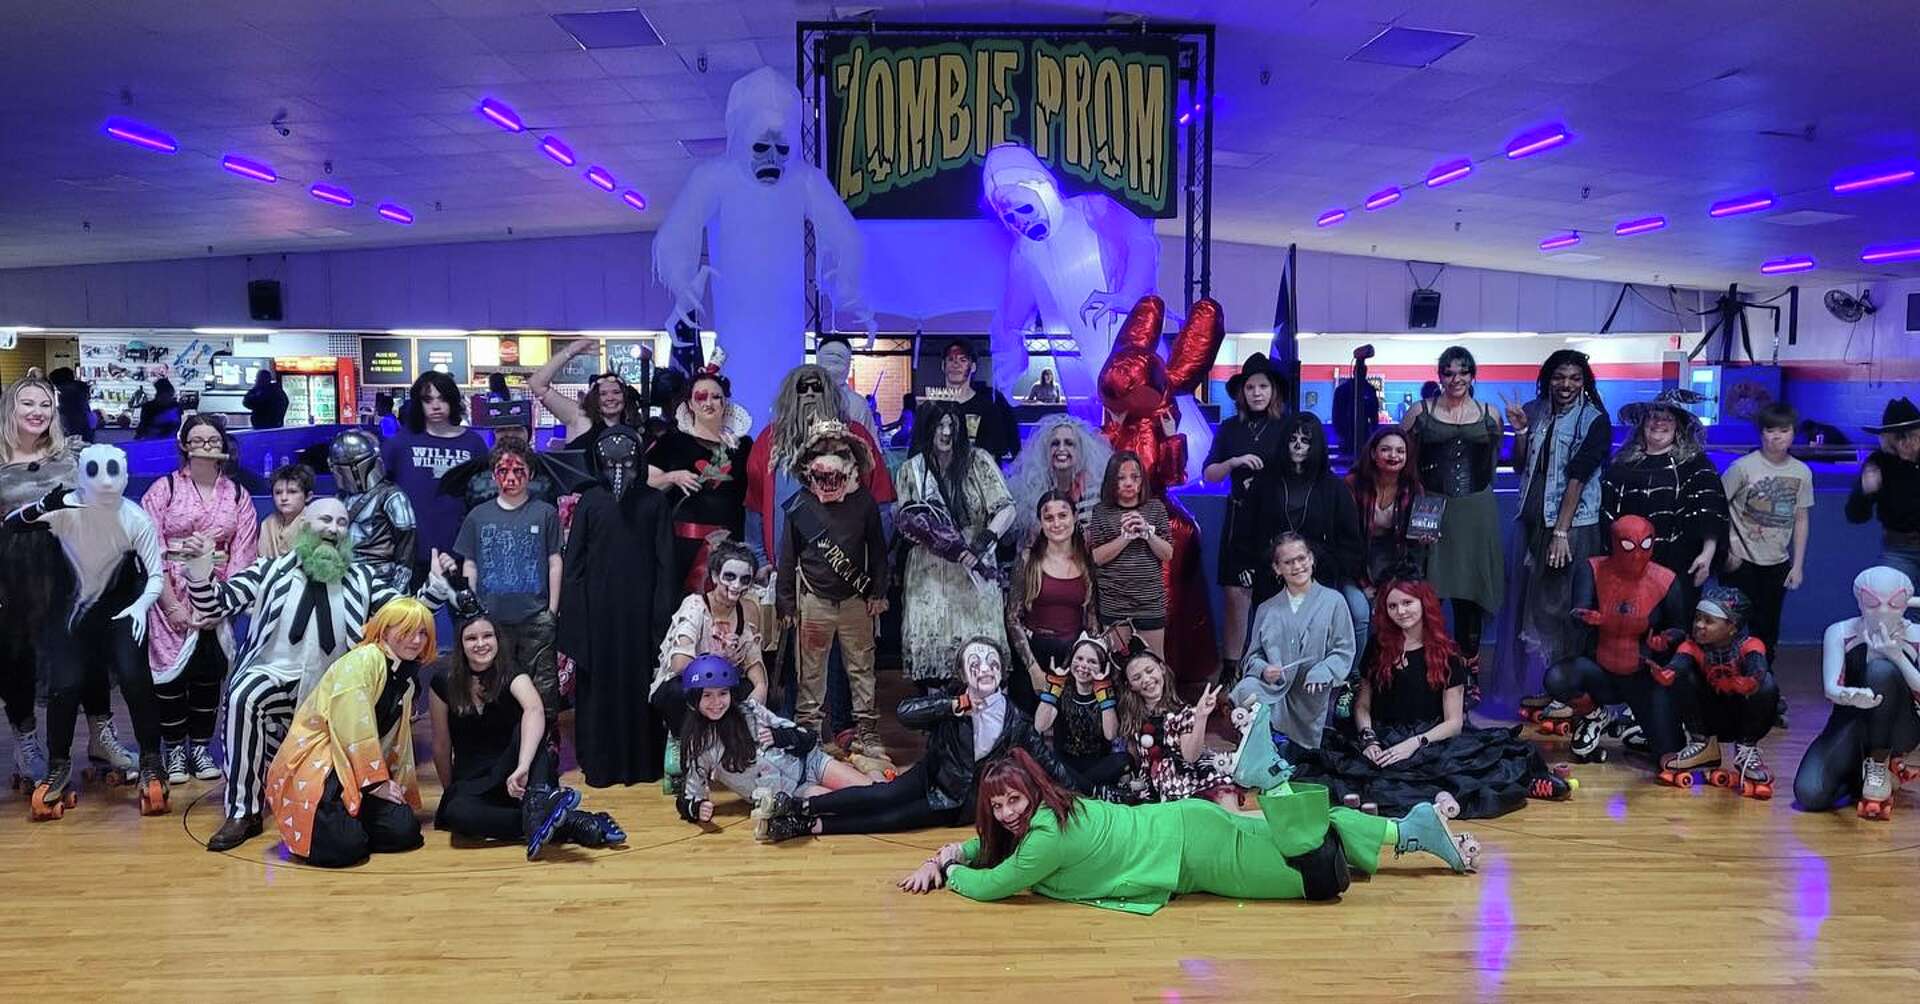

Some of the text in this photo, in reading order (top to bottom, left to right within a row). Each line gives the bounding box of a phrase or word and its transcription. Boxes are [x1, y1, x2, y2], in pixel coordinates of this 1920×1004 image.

[836, 46, 1166, 201] ZOMBIE PROM
[411, 447, 471, 461] WILLIS
